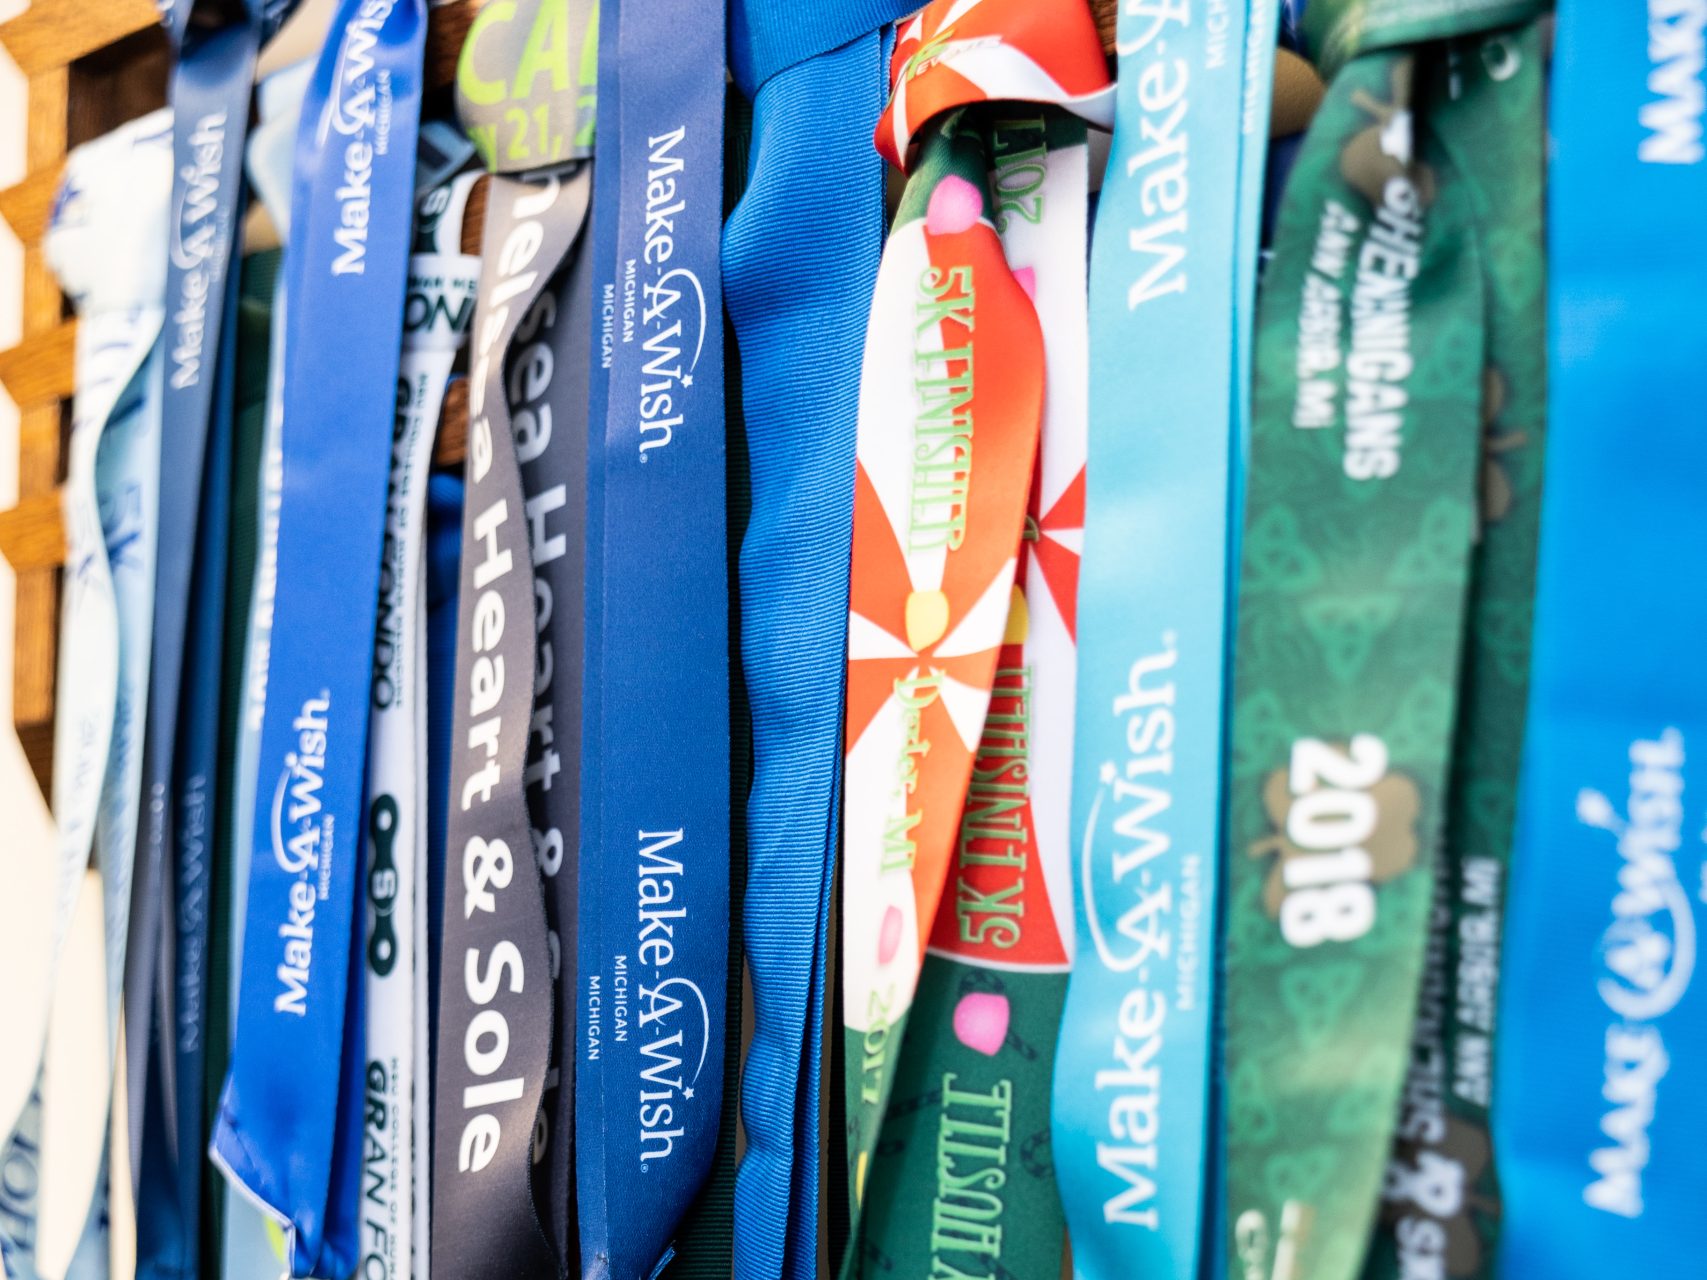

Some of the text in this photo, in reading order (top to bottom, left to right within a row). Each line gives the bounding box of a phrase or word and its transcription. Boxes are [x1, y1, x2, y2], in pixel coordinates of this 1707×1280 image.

[330, 0, 393, 277] Make-A-Wis
[468, 164, 562, 486] helsea
[602, 283, 615, 369] MICHIGAN
[623, 258, 637, 344] MICHIGAN
[907, 265, 976, 557] 5K FINISHER
[461, 498, 513, 812] Heart
[462, 835, 514, 921] &
[957, 877, 1027, 949] 5K
[1279, 733, 1388, 947] 2018
[457, 940, 525, 1174] Sole
[588, 975, 602, 1061] MICHIGAN
[614, 954, 629, 1044] MICHIGAN
[364, 1060, 388, 1206] GRAN
[930, 1072, 1013, 1260] HUSTLE
